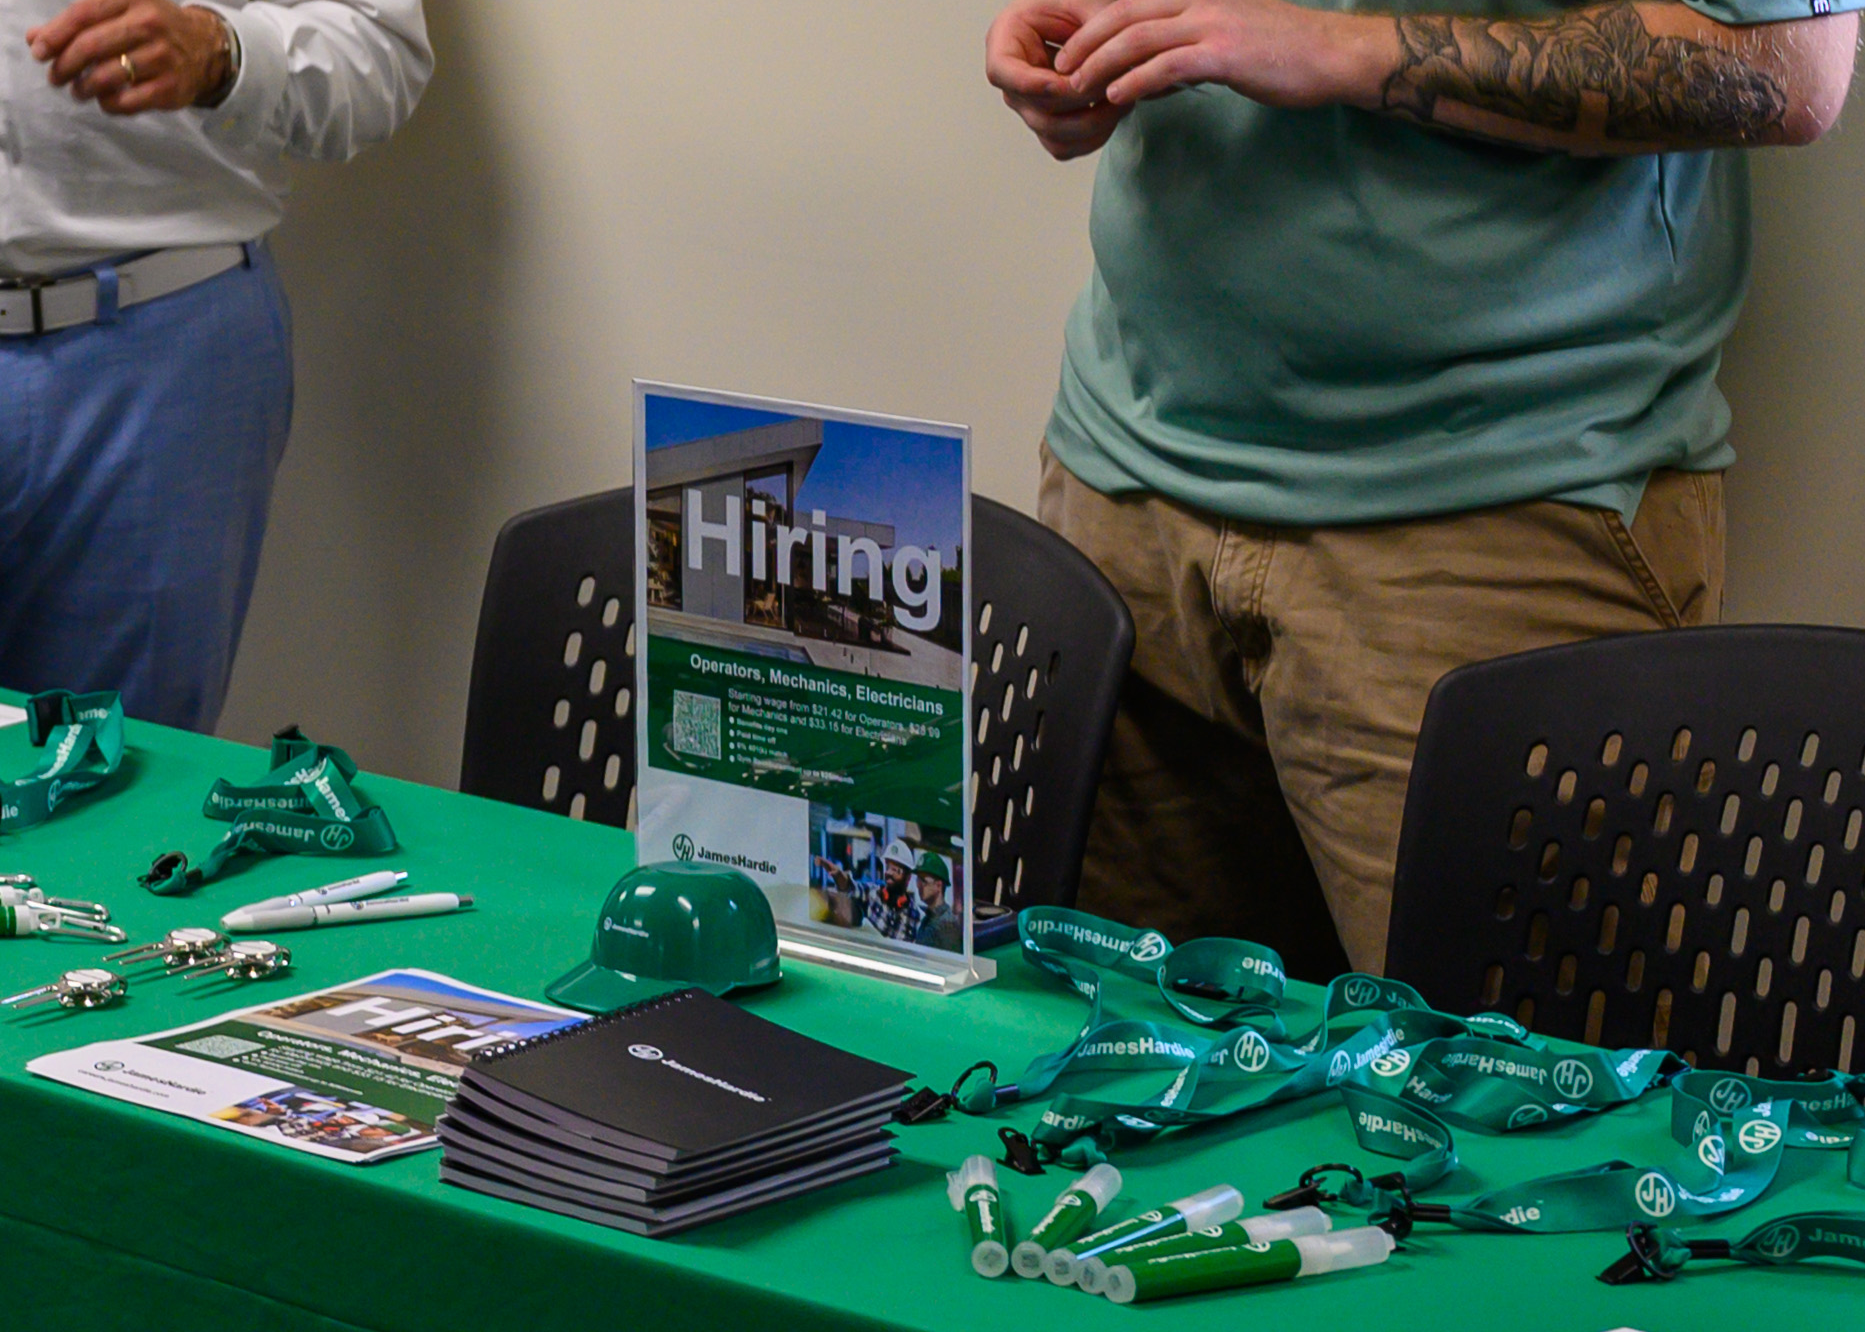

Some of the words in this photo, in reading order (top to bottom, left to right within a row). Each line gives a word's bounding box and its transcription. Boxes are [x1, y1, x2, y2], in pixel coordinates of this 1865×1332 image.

[688, 488, 941, 632] Hiring
[690, 653, 766, 684] Operators,
[770, 668, 852, 700] Mechanics,
[856, 684, 944, 716] Electricians
[728, 687, 762, 706] Starting
[698, 846, 777, 875] JamesHardie
